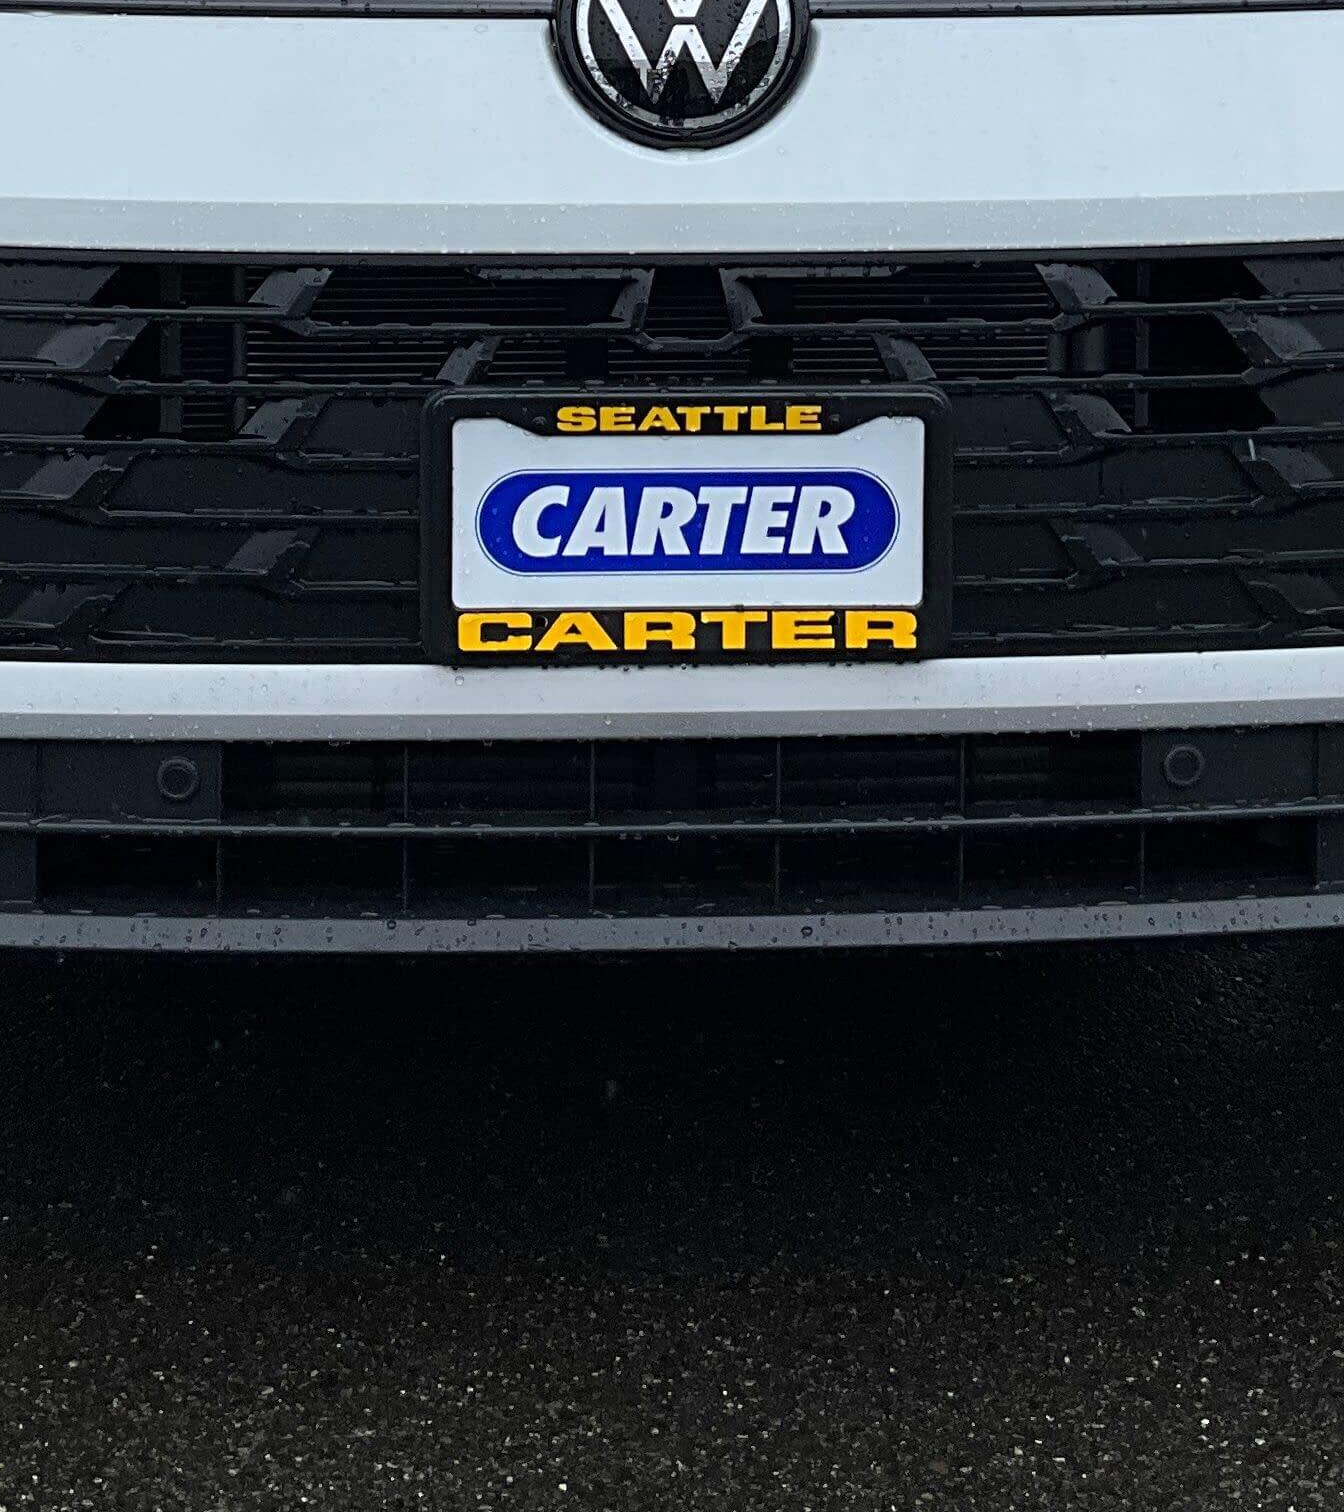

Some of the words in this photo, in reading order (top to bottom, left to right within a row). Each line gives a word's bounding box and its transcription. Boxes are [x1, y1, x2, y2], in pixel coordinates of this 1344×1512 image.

[557, 405, 821, 432] SEATTLE
[512, 485, 855, 556] CARTER
[457, 611, 918, 651] CARTER
